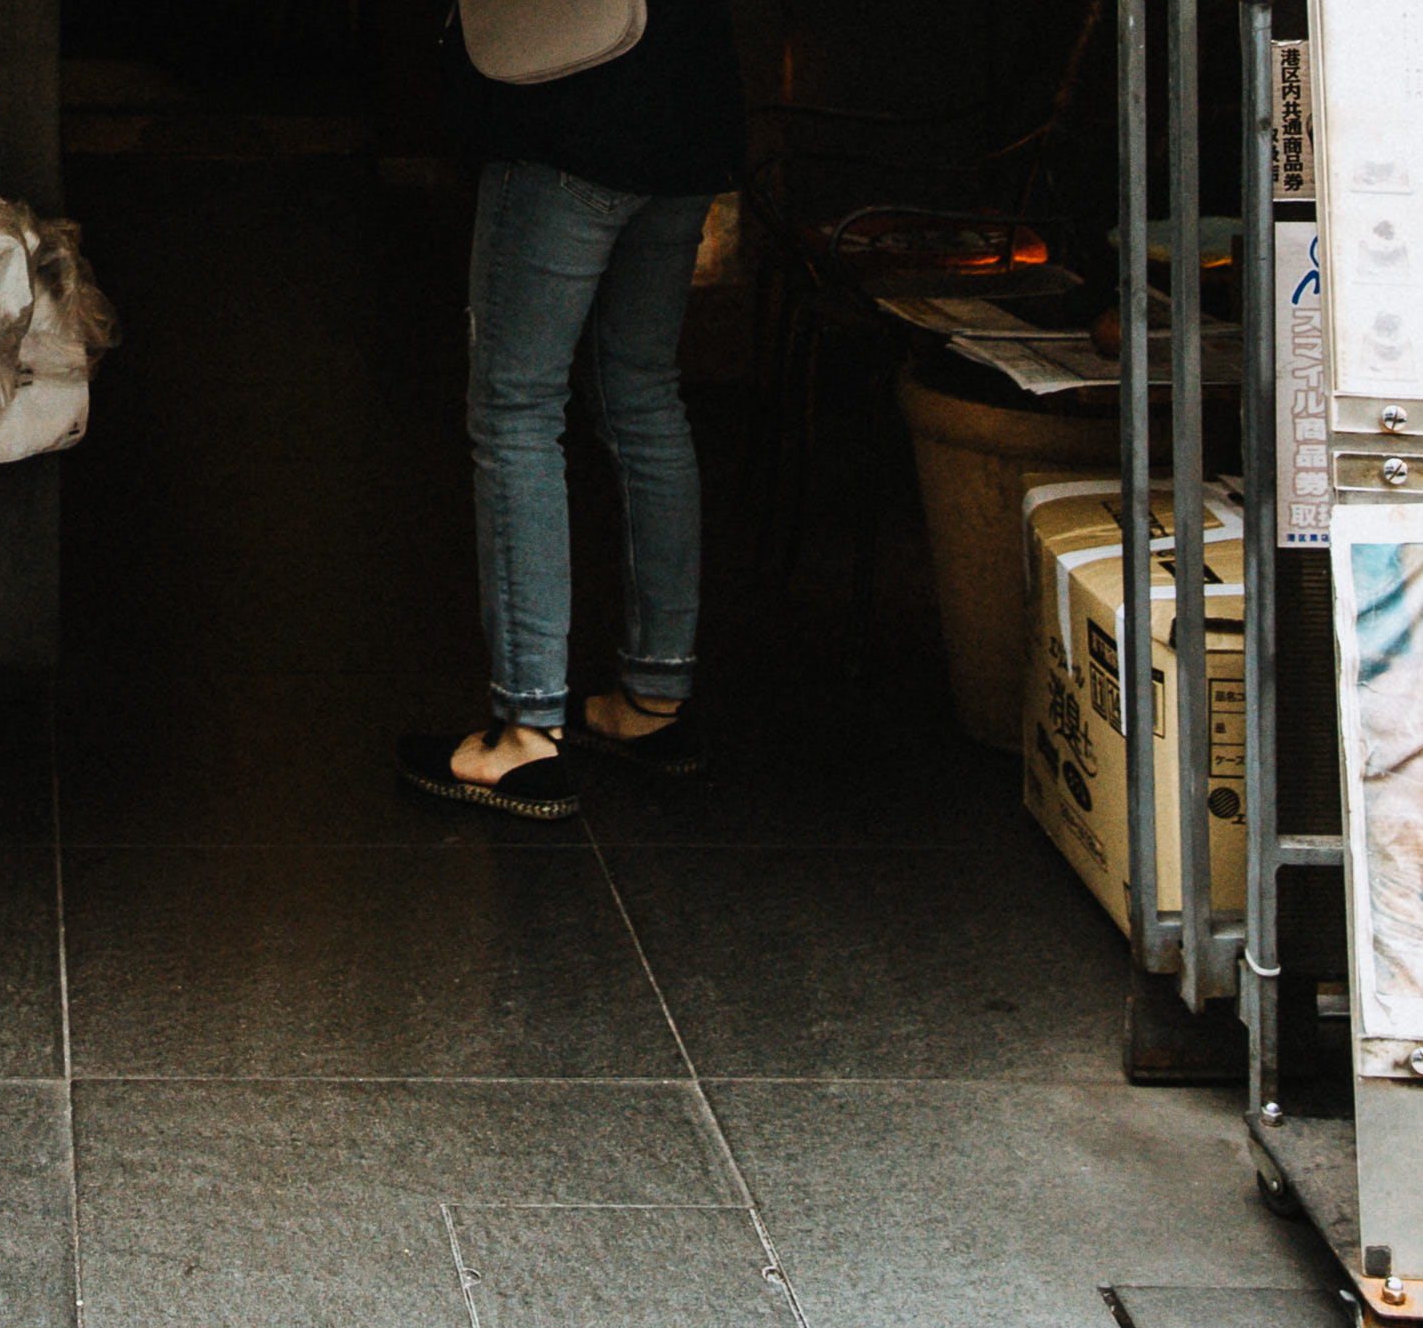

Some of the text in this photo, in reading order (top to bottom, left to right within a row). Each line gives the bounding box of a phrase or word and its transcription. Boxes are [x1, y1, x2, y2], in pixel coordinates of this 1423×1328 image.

[1281, 48, 1303, 192] 港区内共通商品券
